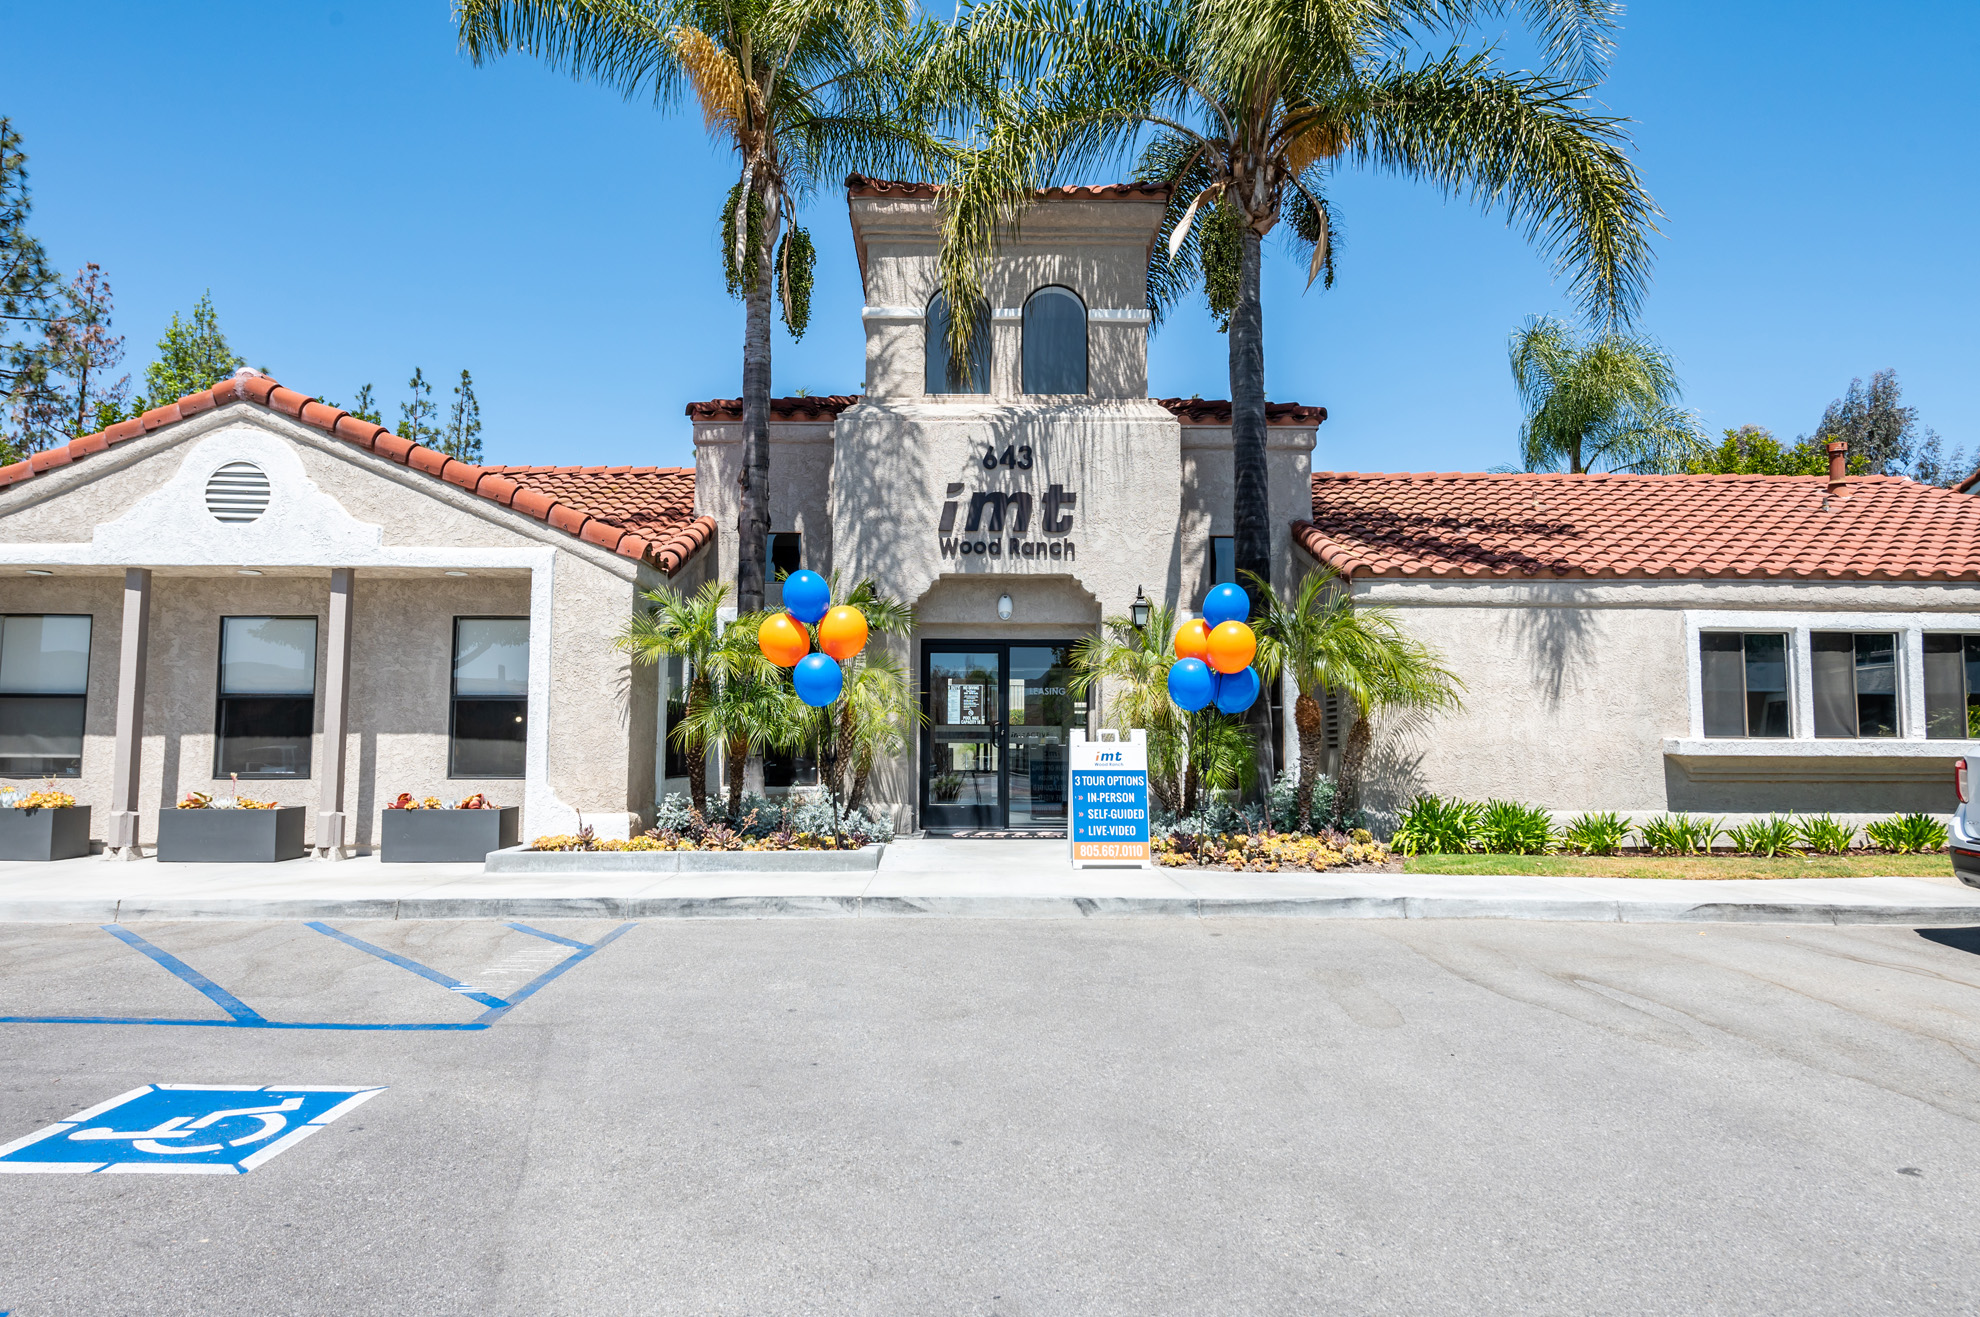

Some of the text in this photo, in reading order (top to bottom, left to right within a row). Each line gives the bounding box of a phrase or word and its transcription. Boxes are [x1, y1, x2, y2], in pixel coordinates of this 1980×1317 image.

[983, 445, 1033, 470] 643
[938, 483, 1077, 533] imt
[939, 537, 1076, 556] Wood Ranch
[1029, 687, 1066, 696] LEASING
[1095, 751, 1123, 762] imt
[1074, 775, 1145, 786] 3 TOUR OPTIONS
[1087, 792, 1135, 803] IN-PERSON
[1087, 808, 1145, 820] SELF-GUIDED
[1088, 825, 1136, 836] LIVE-VIDEO
[1080, 844, 1143, 857] 805.667.0110
